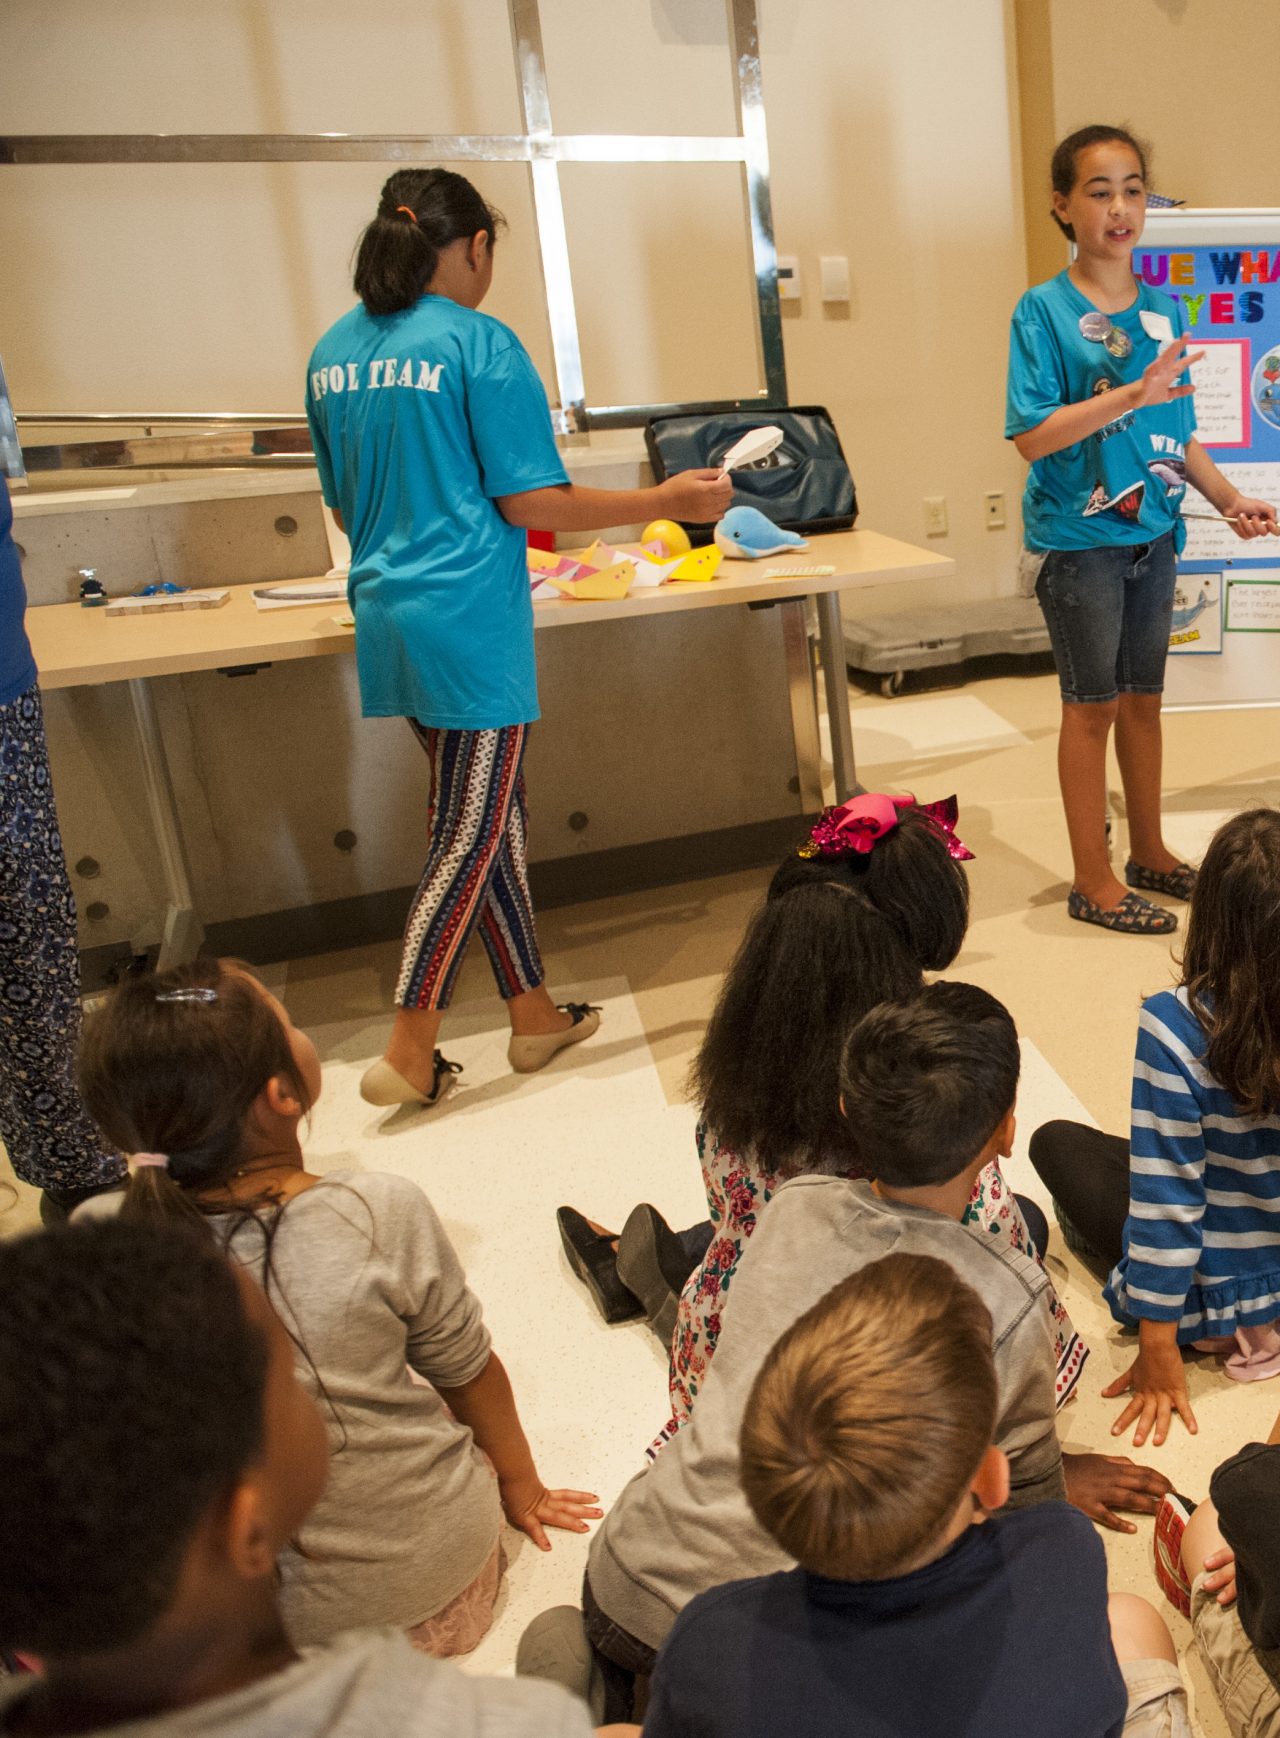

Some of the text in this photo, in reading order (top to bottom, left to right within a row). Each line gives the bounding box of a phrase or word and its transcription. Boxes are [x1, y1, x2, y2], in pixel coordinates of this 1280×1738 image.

[1168, 291, 1264, 326] YES
[367, 358, 445, 393] TEAM
[1149, 434, 1186, 459] WHA
